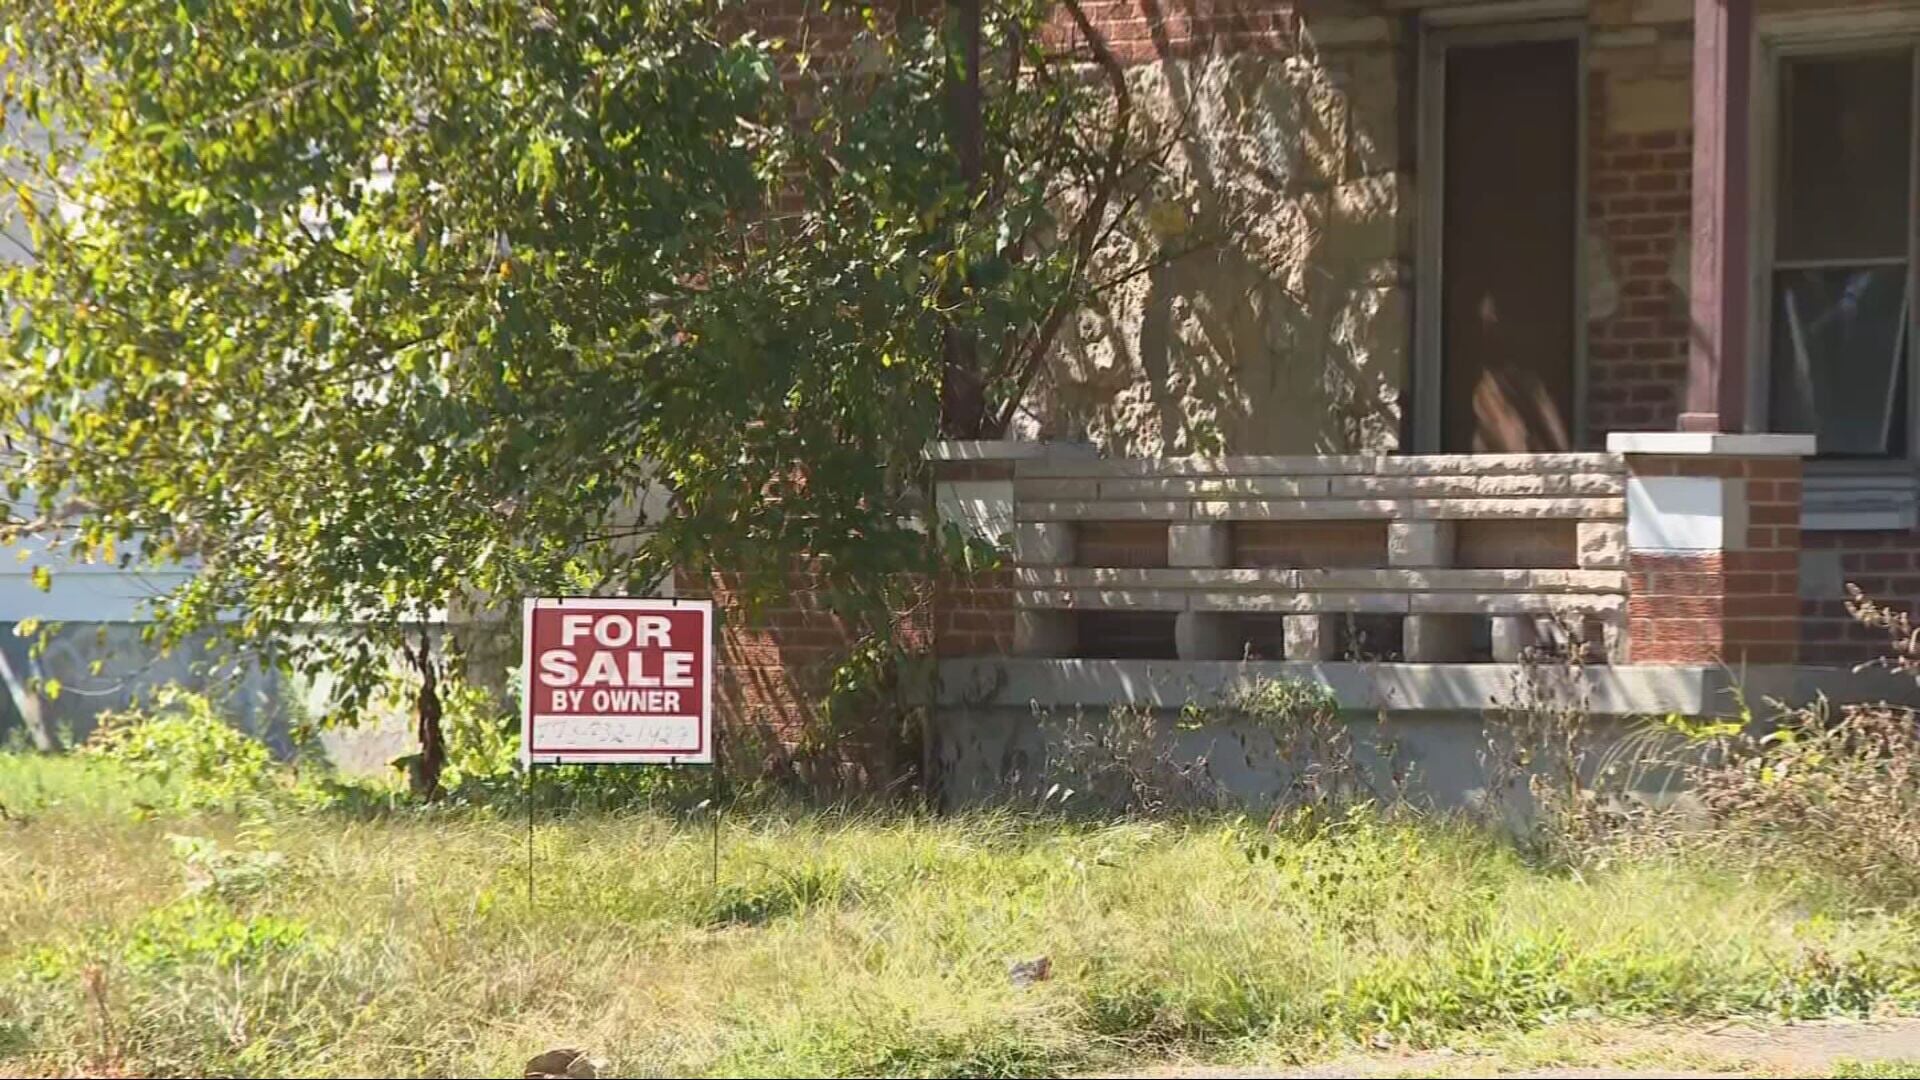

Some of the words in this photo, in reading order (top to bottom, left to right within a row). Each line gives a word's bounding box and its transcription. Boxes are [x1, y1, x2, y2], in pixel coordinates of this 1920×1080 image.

[562, 614, 672, 647] FOR
[539, 649, 694, 688] SALE
[551, 690, 584, 712] BY
[592, 690, 680, 713] OWNER
